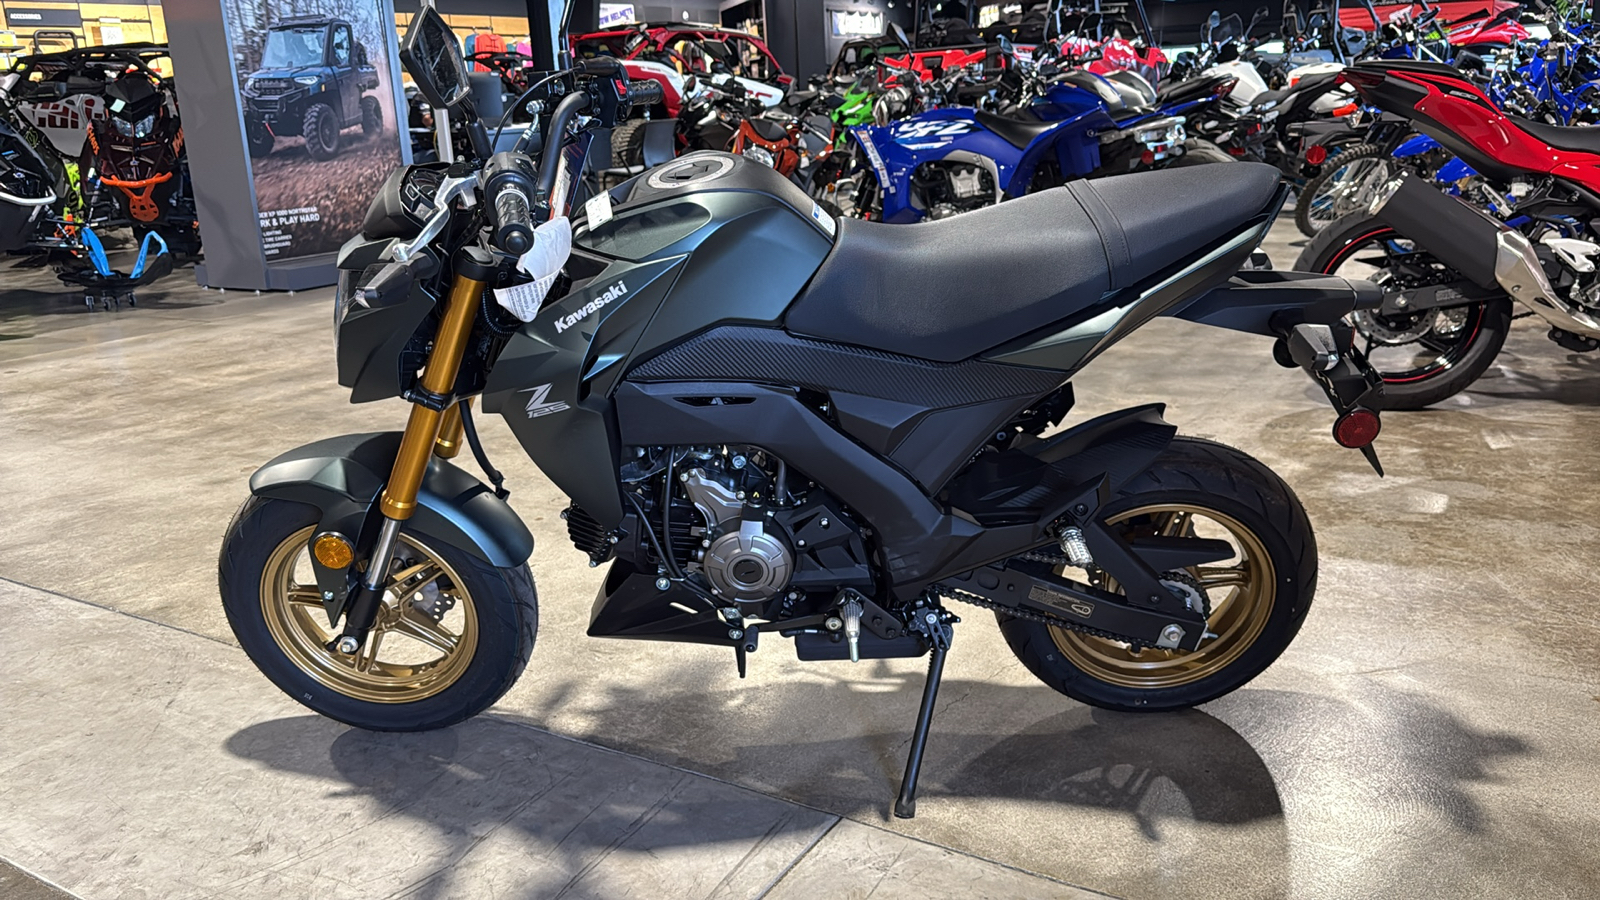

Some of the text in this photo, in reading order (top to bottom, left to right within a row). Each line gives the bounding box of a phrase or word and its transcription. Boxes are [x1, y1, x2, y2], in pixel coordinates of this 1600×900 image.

[272, 218, 279, 227] &
[279, 216, 299, 226] PLAY
[299, 213, 320, 224] HARD
[554, 280, 628, 334] Kawasaki
[516, 382, 566, 412] Z
[527, 403, 571, 419] 125
